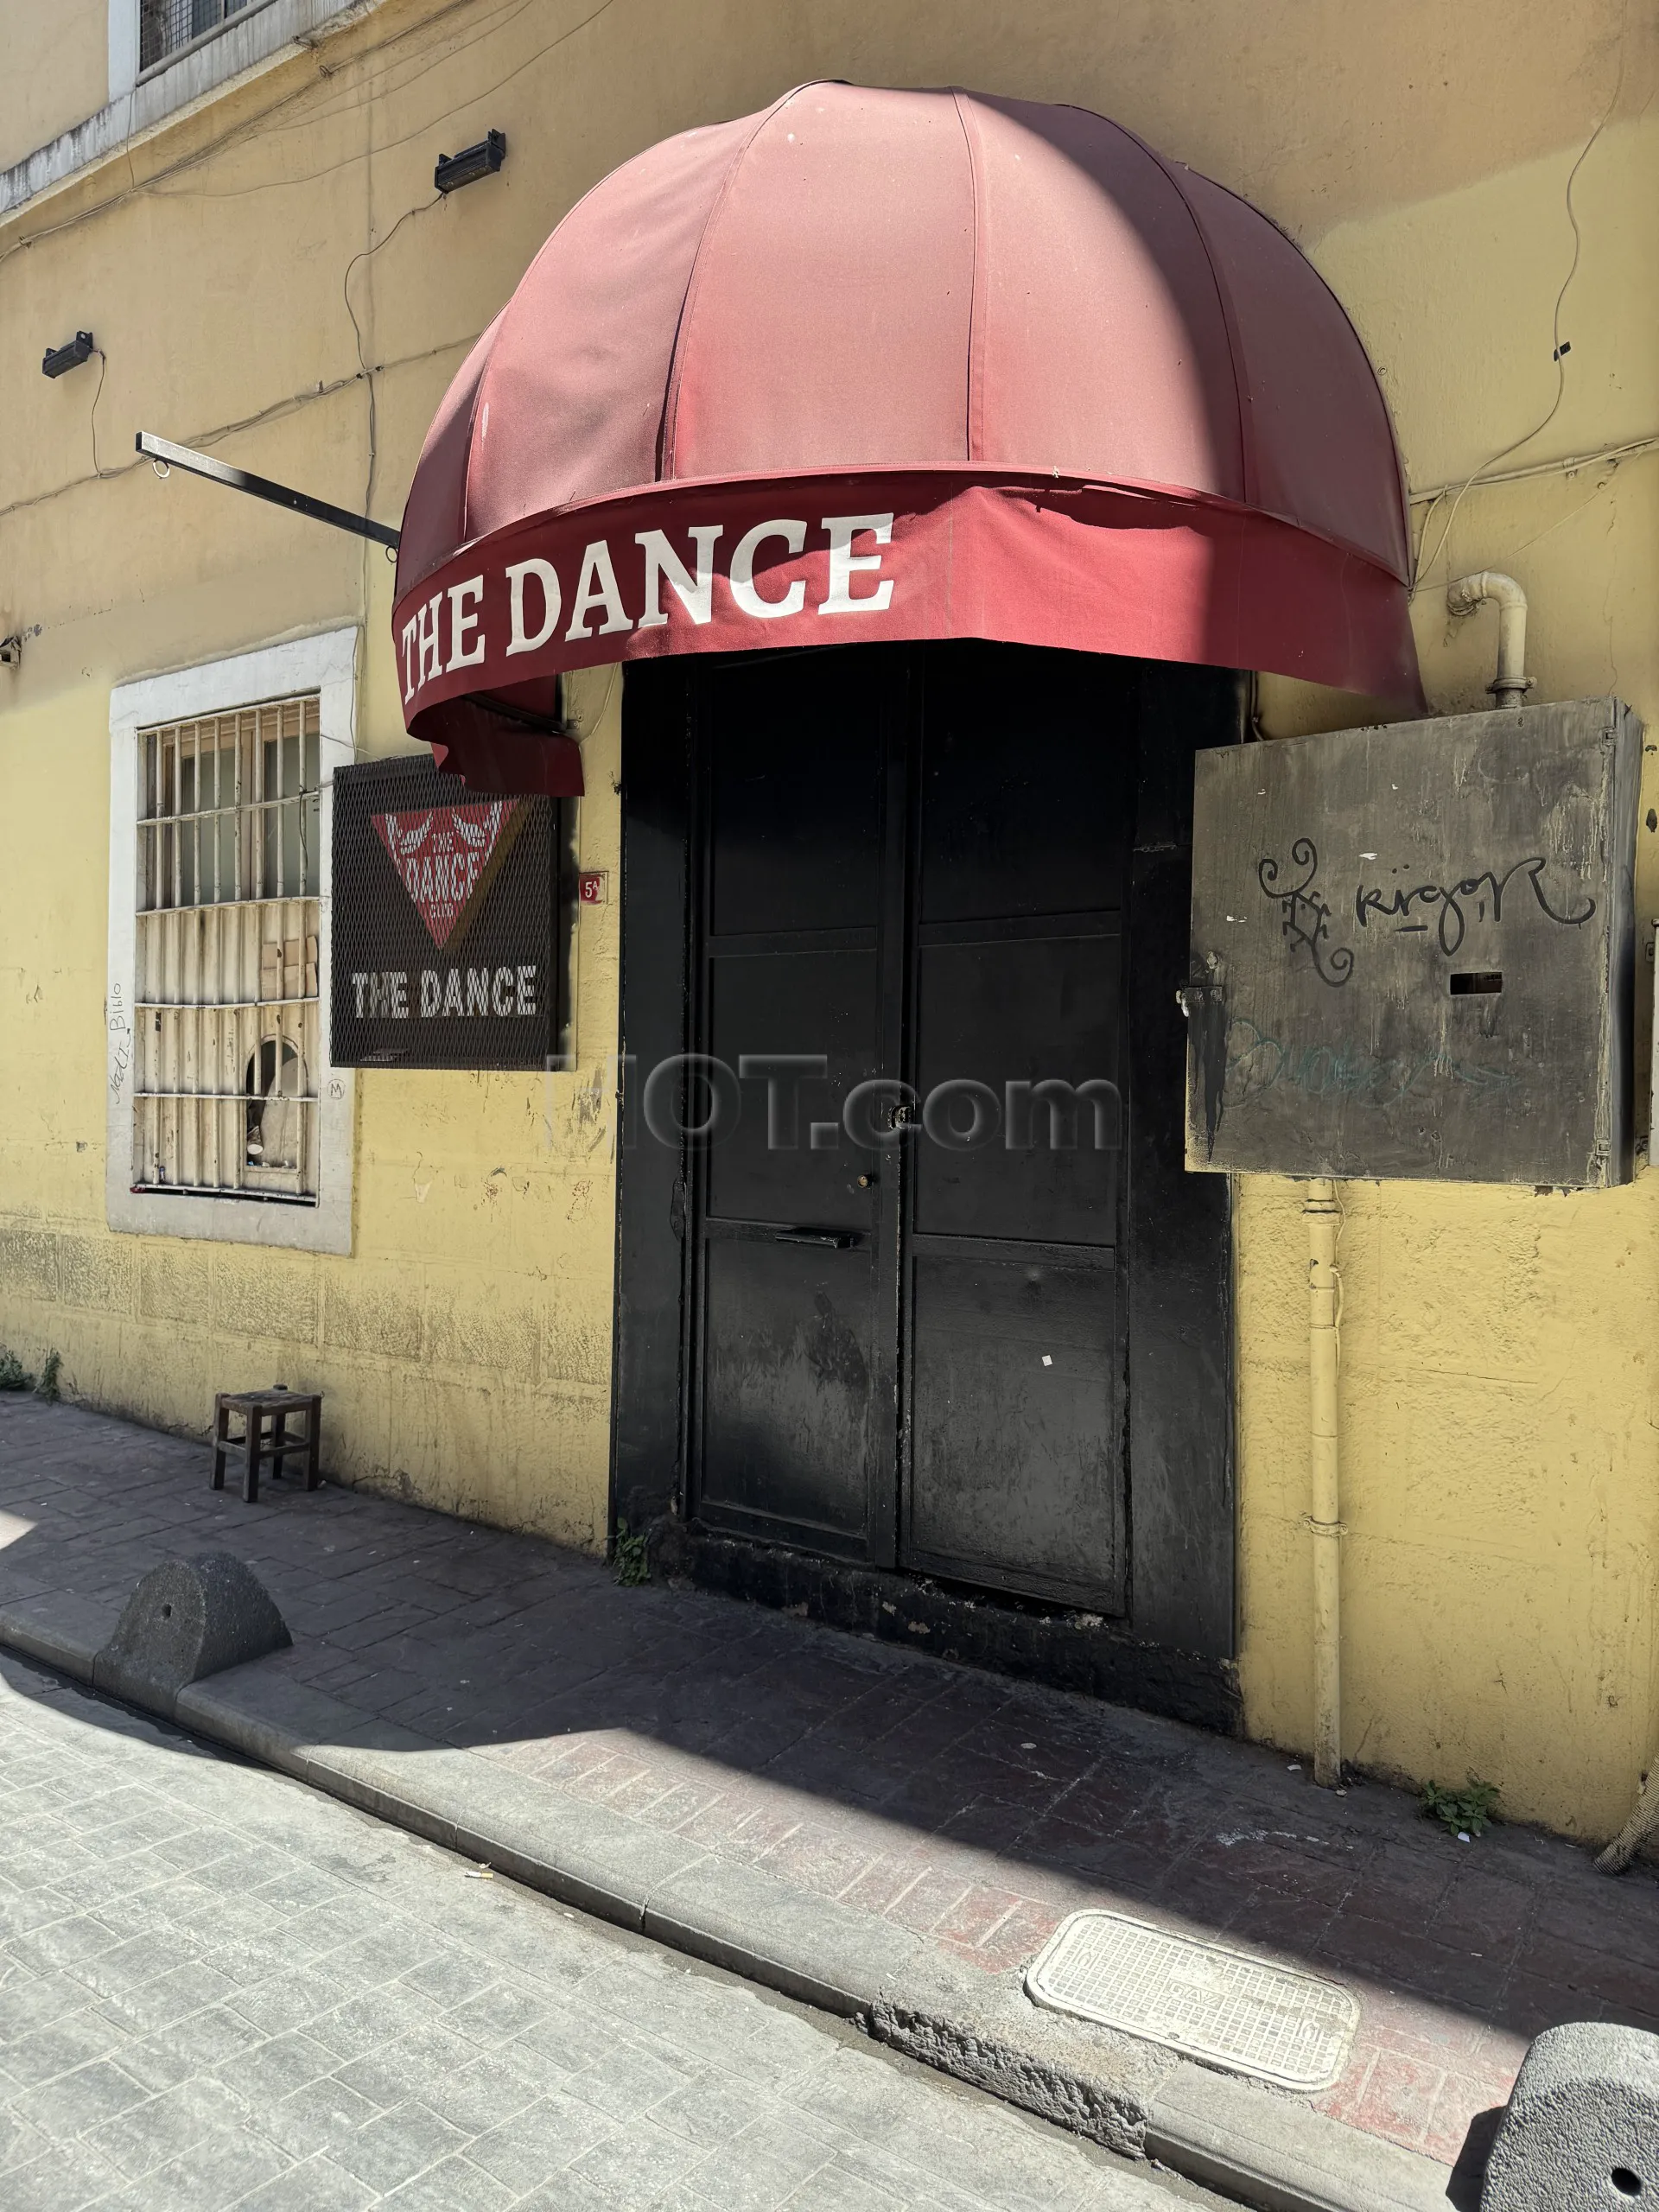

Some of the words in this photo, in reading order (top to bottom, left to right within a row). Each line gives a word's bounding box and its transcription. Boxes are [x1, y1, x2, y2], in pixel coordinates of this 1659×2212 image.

[401, 574, 486, 704] THE
[505, 512, 895, 657] DANCE
[431, 831, 454, 853] THE
[406, 852, 480, 903] DANCE
[352, 971, 410, 1019] THE
[420, 965, 537, 1018] DANCE
[1169, 1981, 1219, 2010] GAZ
